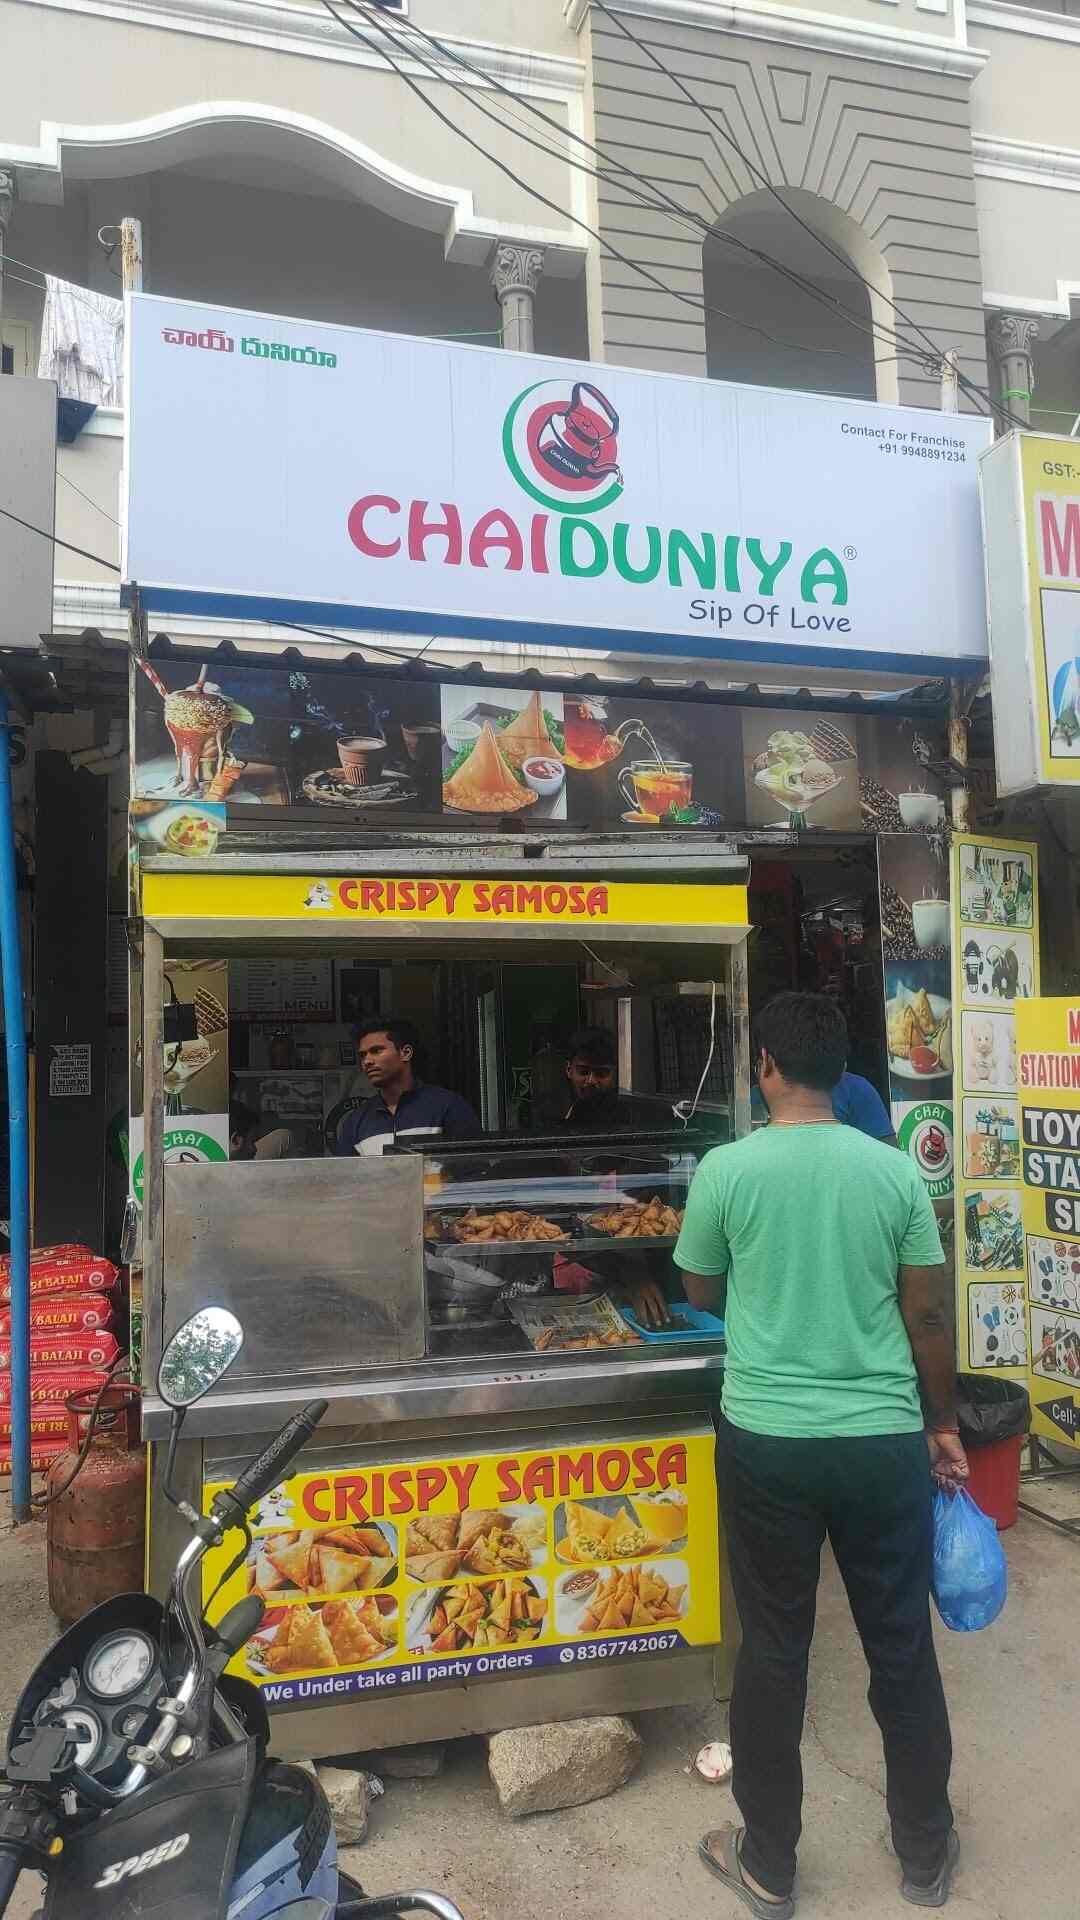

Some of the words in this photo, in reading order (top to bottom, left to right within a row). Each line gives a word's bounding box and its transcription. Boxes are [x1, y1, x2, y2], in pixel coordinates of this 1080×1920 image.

[240, 337, 337, 368] దునియా
[841, 423, 885, 438] Contact
[888, 429, 908, 440] For
[911, 432, 966, 448] Franchise
[878, 443, 897, 454] +91
[901, 445, 966, 462] 9948891234
[689, 599, 732, 628] Sip
[743, 604, 780, 628] Of
[791, 607, 852, 632] Love
[338, 880, 462, 915] CRISPY
[473, 882, 609, 917] SAMOSA
[914, 1106, 945, 1121] CHAI
[1028, 1152, 1080, 1190] STA
[42, 1350, 83, 1361] BALAJI
[1052, 1404, 1076, 1425] Cell:
[302, 1463, 479, 1524] CRISPY
[496, 1443, 688, 1504] SAMOSA
[264, 1687, 293, 1701] We
[298, 1678, 352, 1696] Under
[357, 1670, 396, 1688] take
[401, 1666, 421, 1681] all
[427, 1661, 471, 1681] party
[476, 1653, 533, 1673] Orders
[577, 1634, 678, 1661] 8367742067
[93, 1833, 190, 1889] SPEED
